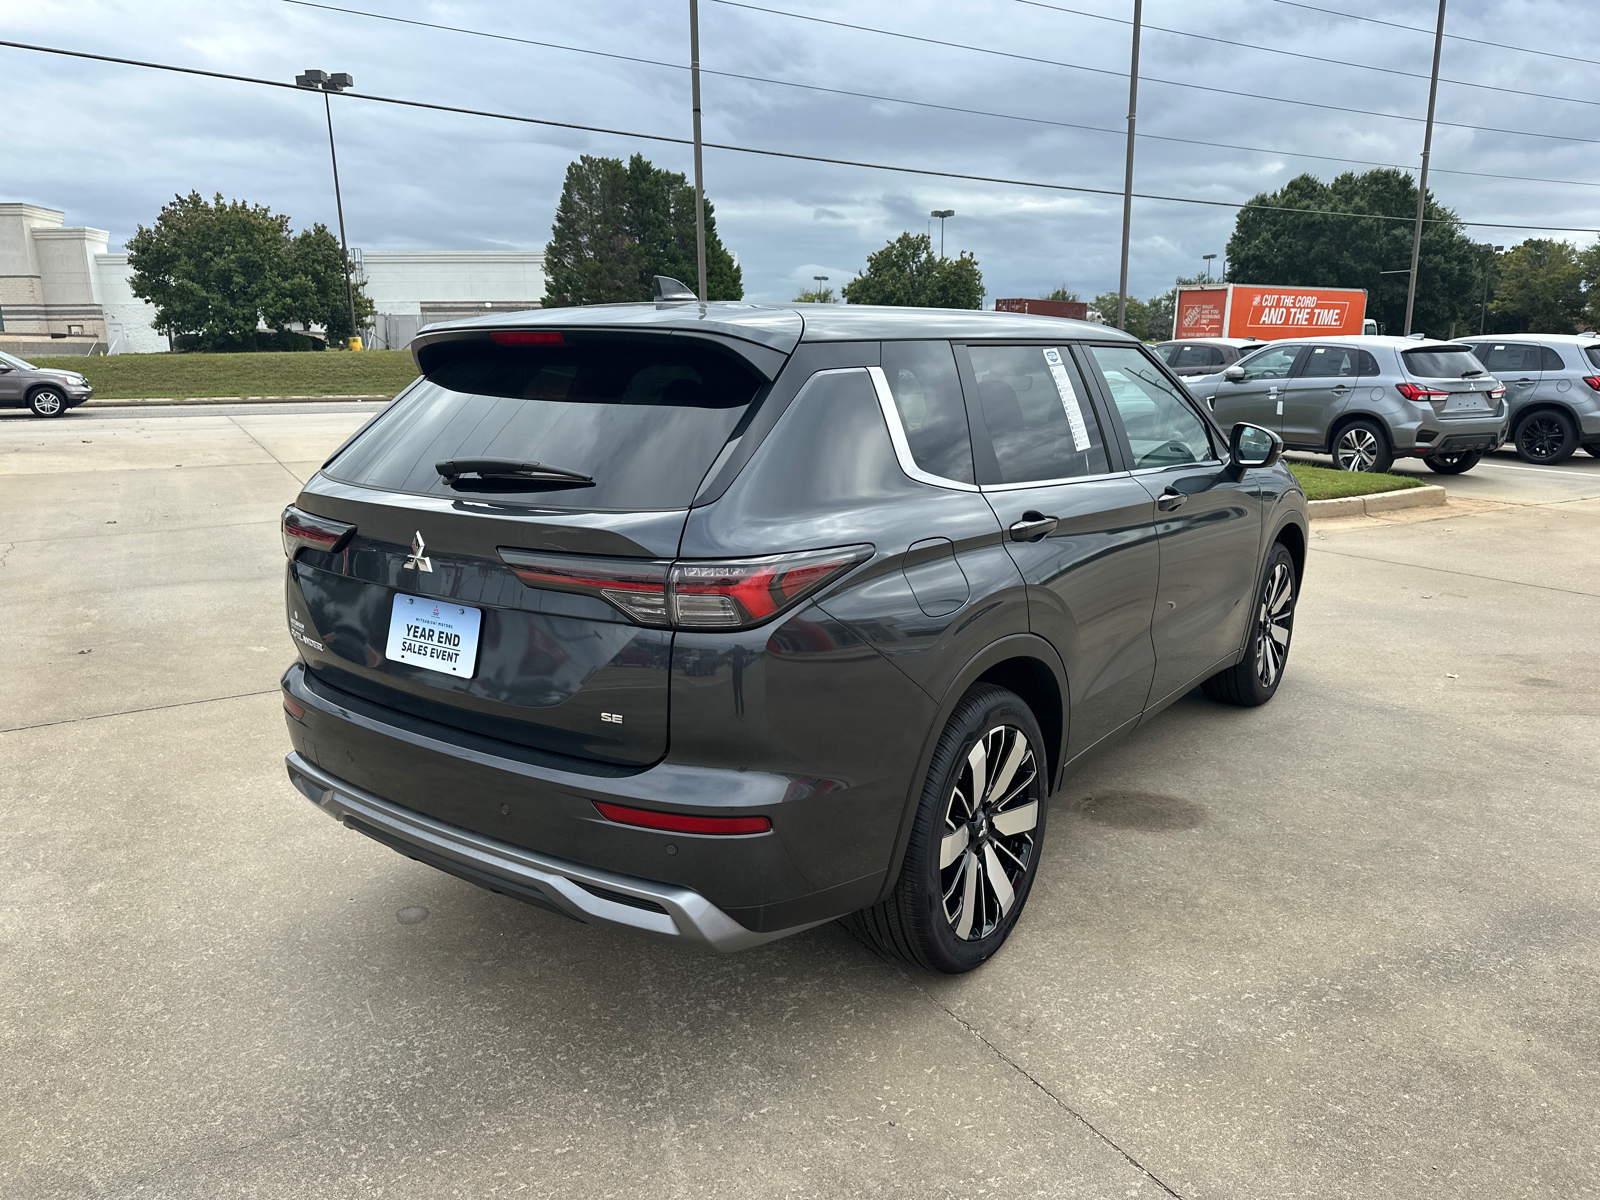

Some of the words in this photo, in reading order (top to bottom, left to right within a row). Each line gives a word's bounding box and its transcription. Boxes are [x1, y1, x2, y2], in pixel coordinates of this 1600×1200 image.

[1262, 294, 1279, 306] CUT
[1280, 295, 1295, 307] THE
[1295, 296, 1317, 307] CORD
[1183, 305, 1202, 326] HOME
[1259, 308, 1287, 324] AND
[1288, 308, 1311, 325] THE
[1312, 309, 1341, 325] TIME.
[415, 617, 437, 625] MITSUBISHI
[406, 623, 435, 642] YEAR
[437, 630, 461, 647] END
[401, 641, 428, 657] SALES
[429, 647, 460, 664] EVENT
[600, 712, 623, 724] SE
